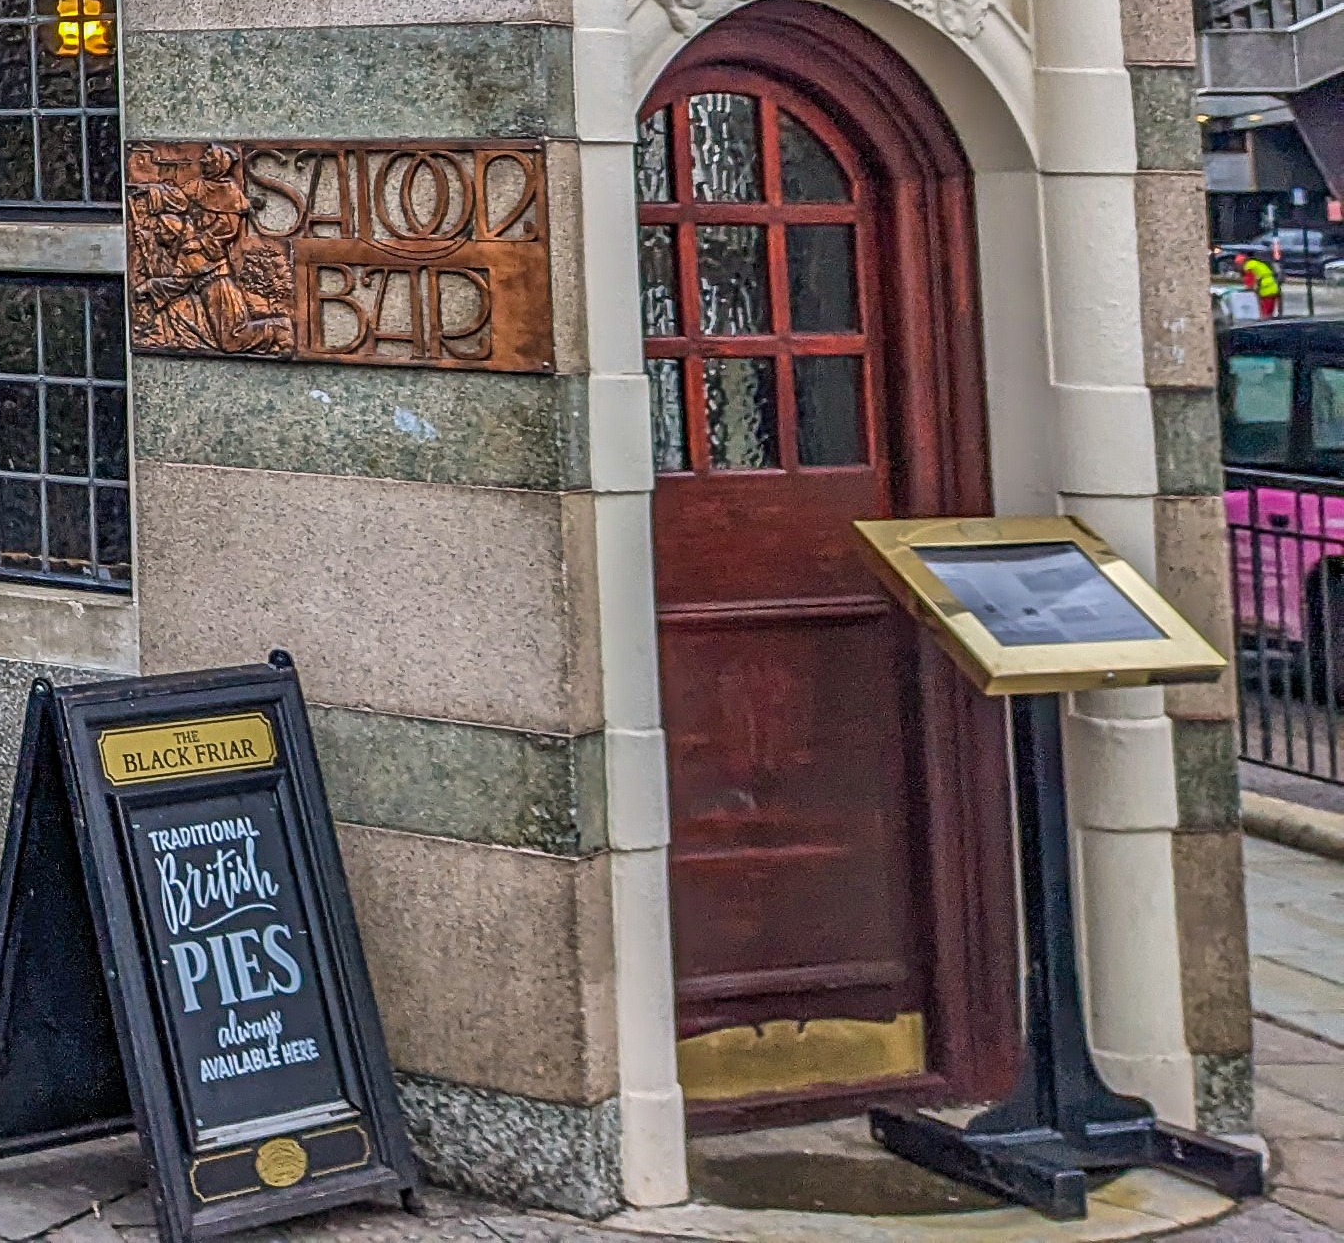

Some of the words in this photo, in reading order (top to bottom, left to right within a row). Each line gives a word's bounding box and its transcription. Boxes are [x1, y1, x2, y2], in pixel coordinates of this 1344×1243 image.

[245, 149, 539, 259] SALOON
[312, 264, 493, 359] BAR
[123, 747, 192, 773] BLACK
[195, 738, 257, 764] FRIAR
[173, 730, 201, 745] THE
[148, 816, 260, 852] TRADITIONAL
[155, 837, 279, 935] British
[169, 924, 302, 1013] PIES
[218, 1009, 283, 1050] always
[199, 1045, 281, 1082] AVAILABLE
[281, 1038, 320, 1066] HERE
